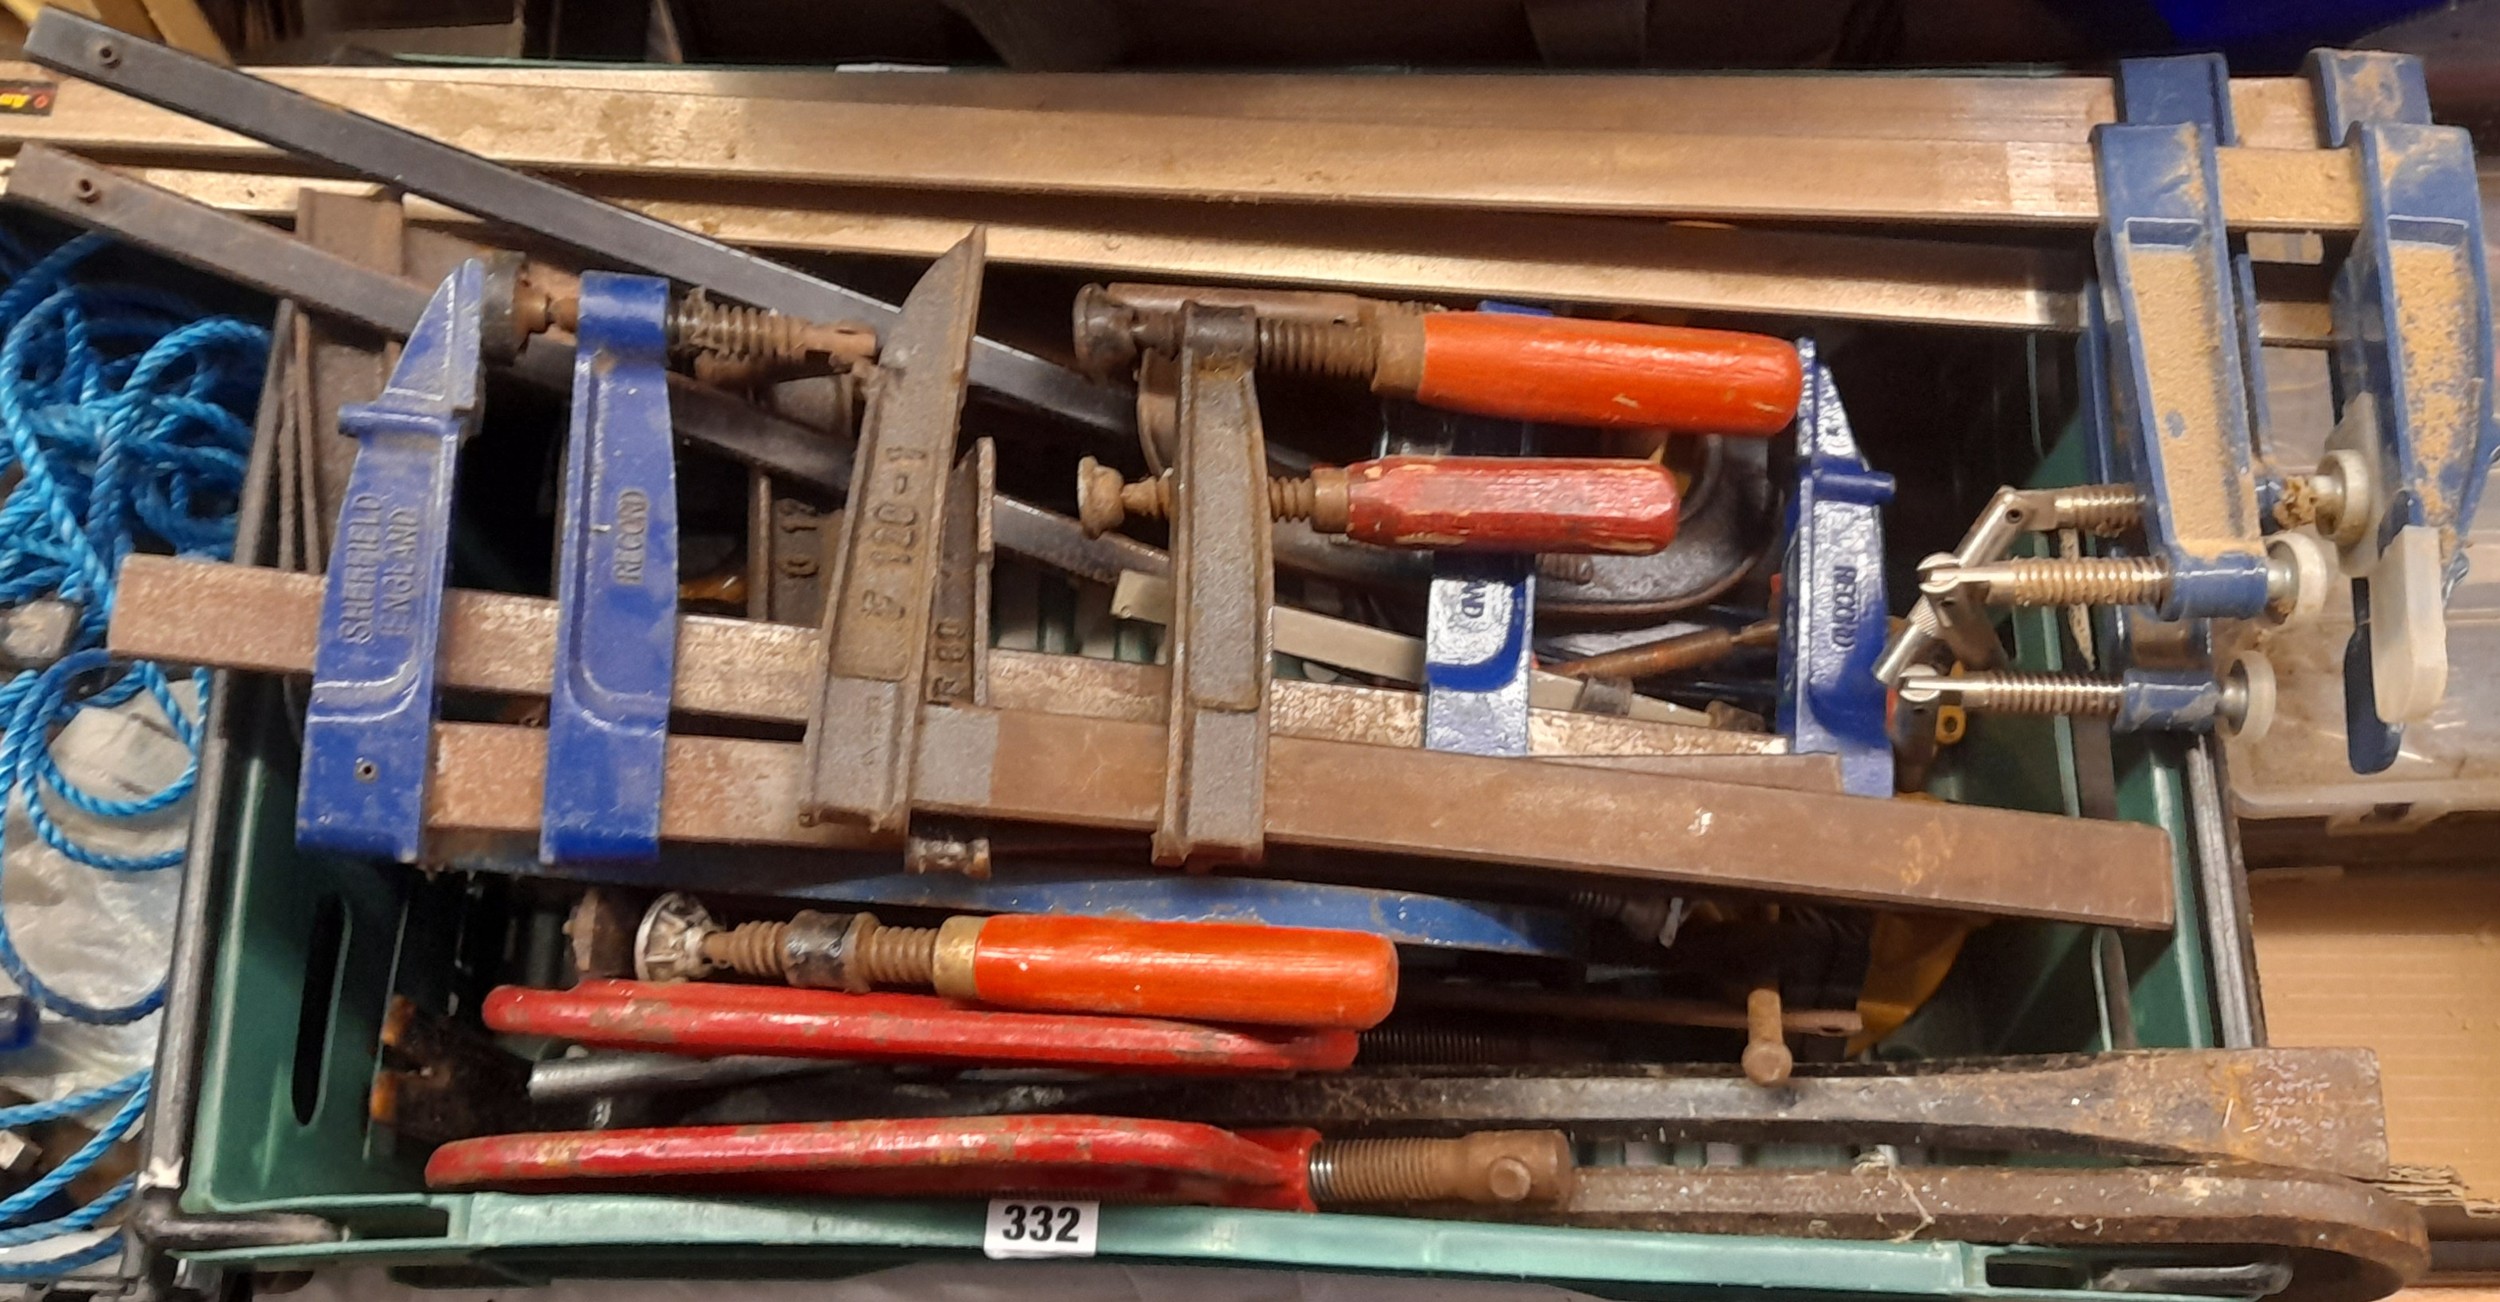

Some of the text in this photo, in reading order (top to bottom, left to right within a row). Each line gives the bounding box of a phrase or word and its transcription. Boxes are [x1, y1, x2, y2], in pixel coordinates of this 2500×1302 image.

[338, 492, 382, 644] SHEFFIELD
[379, 508, 418, 635] ENGLAND
[615, 491, 646, 582] RECORD
[1832, 566, 1857, 648] RECORD
[1002, 1204, 1081, 1243] 332
